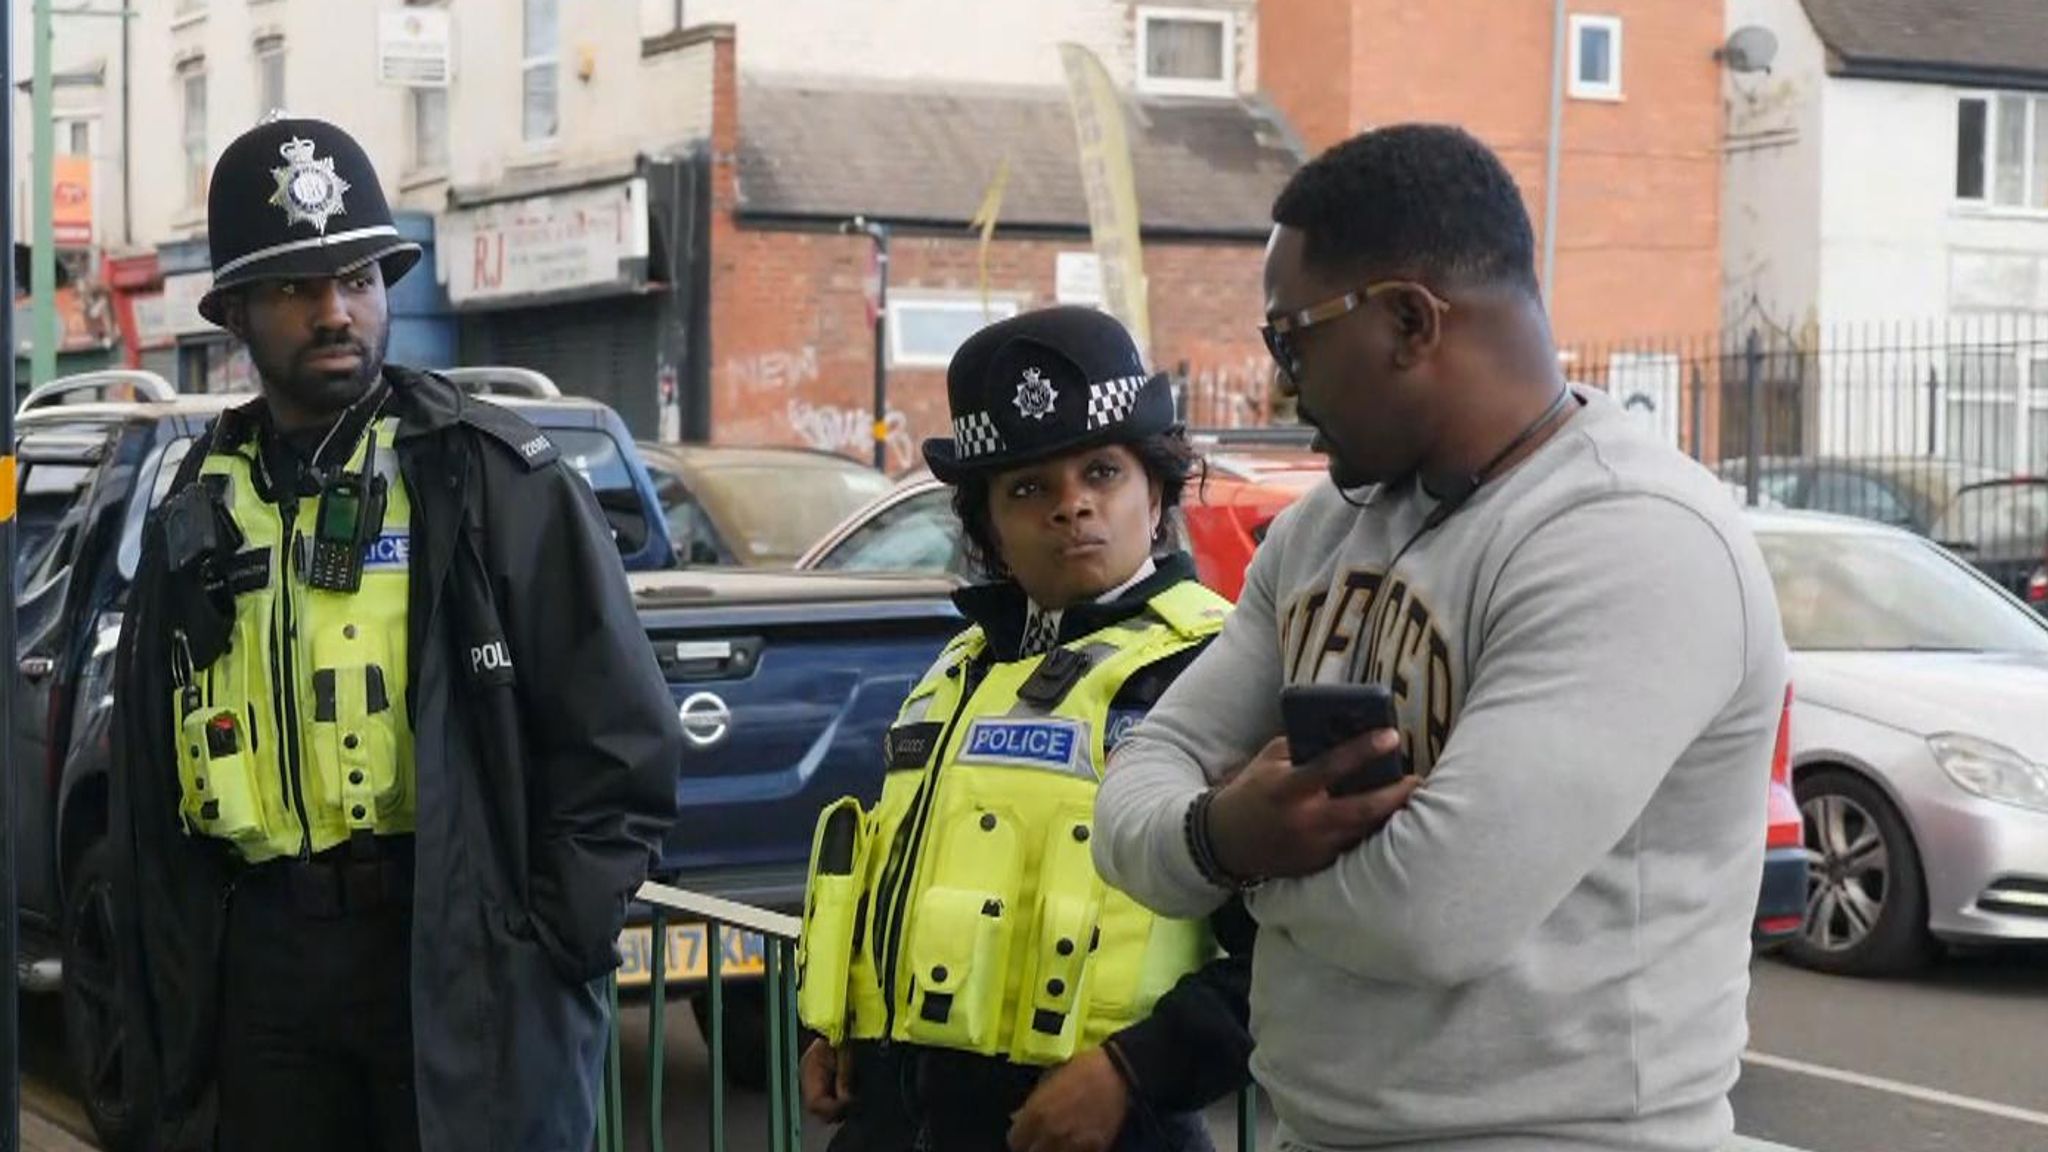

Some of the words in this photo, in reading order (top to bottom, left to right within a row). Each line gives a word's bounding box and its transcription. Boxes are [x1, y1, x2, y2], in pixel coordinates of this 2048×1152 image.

[473, 234, 504, 289] RJ
[364, 537, 410, 560] ICE
[973, 726, 1068, 757] POLICE
